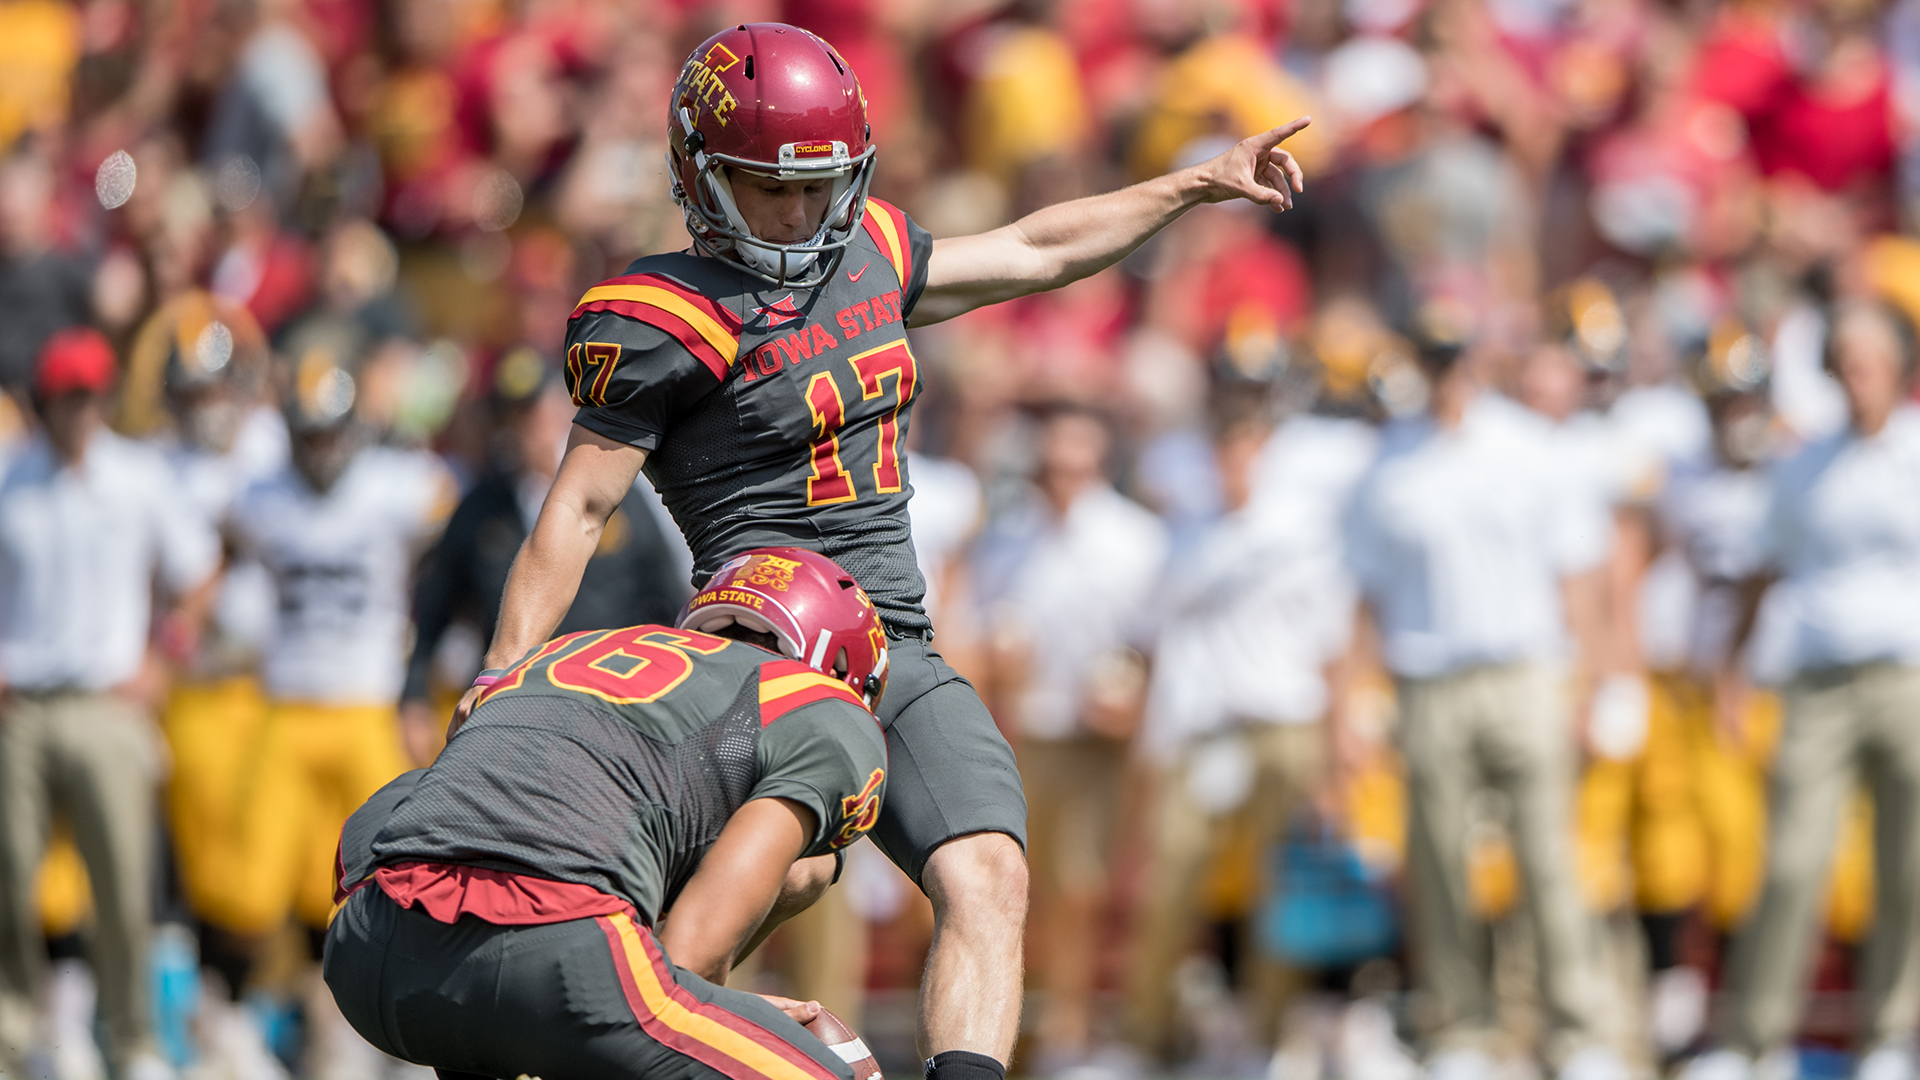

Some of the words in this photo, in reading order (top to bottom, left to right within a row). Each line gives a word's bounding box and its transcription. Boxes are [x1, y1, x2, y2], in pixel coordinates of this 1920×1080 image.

[795, 145, 833, 153] CYCLONES
[568, 342, 622, 407] 17
[739, 322, 838, 383] IOWA
[805, 338, 917, 507] 17
[718, 590, 765, 610] STATE
[475, 624, 732, 705] 16
